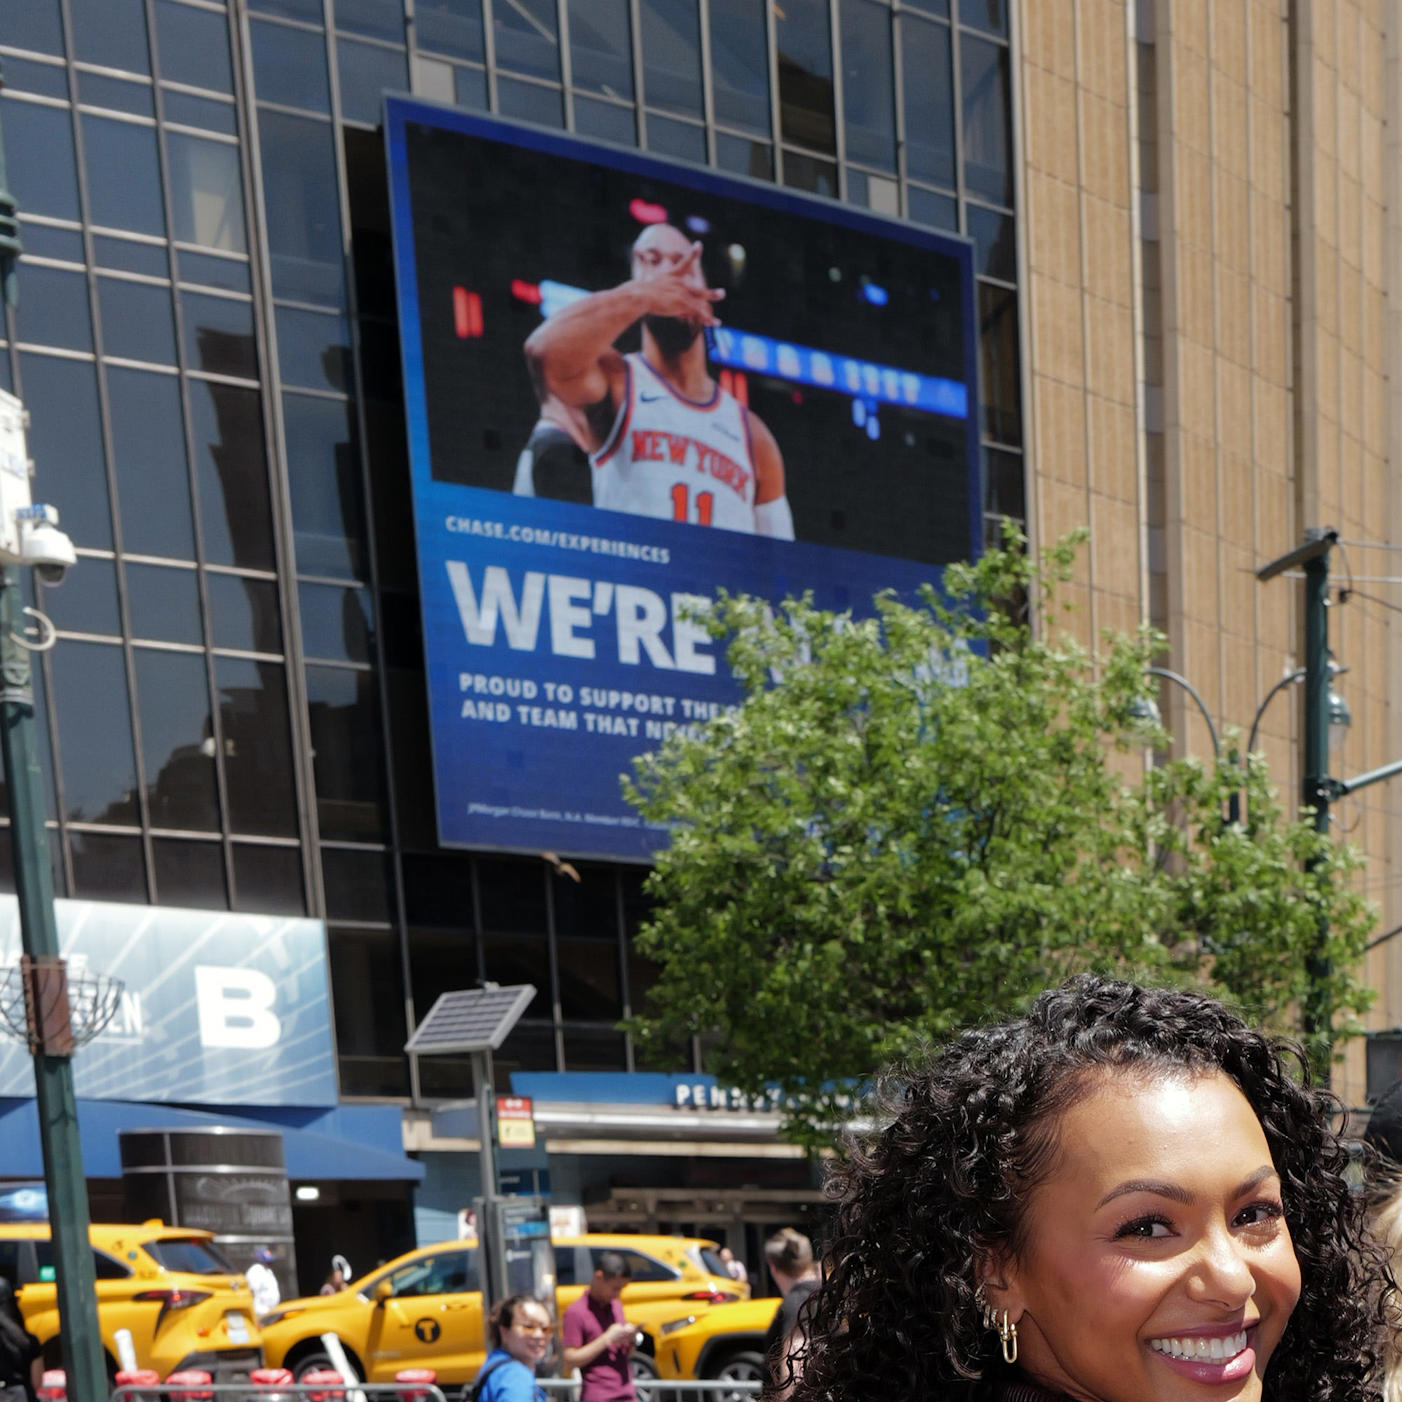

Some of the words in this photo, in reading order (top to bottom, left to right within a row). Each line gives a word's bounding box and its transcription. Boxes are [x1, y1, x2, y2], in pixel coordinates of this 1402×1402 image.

[631, 430, 690, 466] NEW
[693, 439, 750, 502] YORK
[670, 481, 714, 527] 11
[445, 515, 670, 564] CHASE.COM/EXPERIENCES
[445, 560, 717, 675] WE'RE
[459, 672, 537, 700] PROUD
[544, 682, 573, 703] TO
[579, 686, 677, 716] SUPPORT
[461, 699, 511, 723] AND
[517, 705, 578, 730] TEAM
[584, 712, 640, 737] THAT
[195, 965, 281, 1049] B
